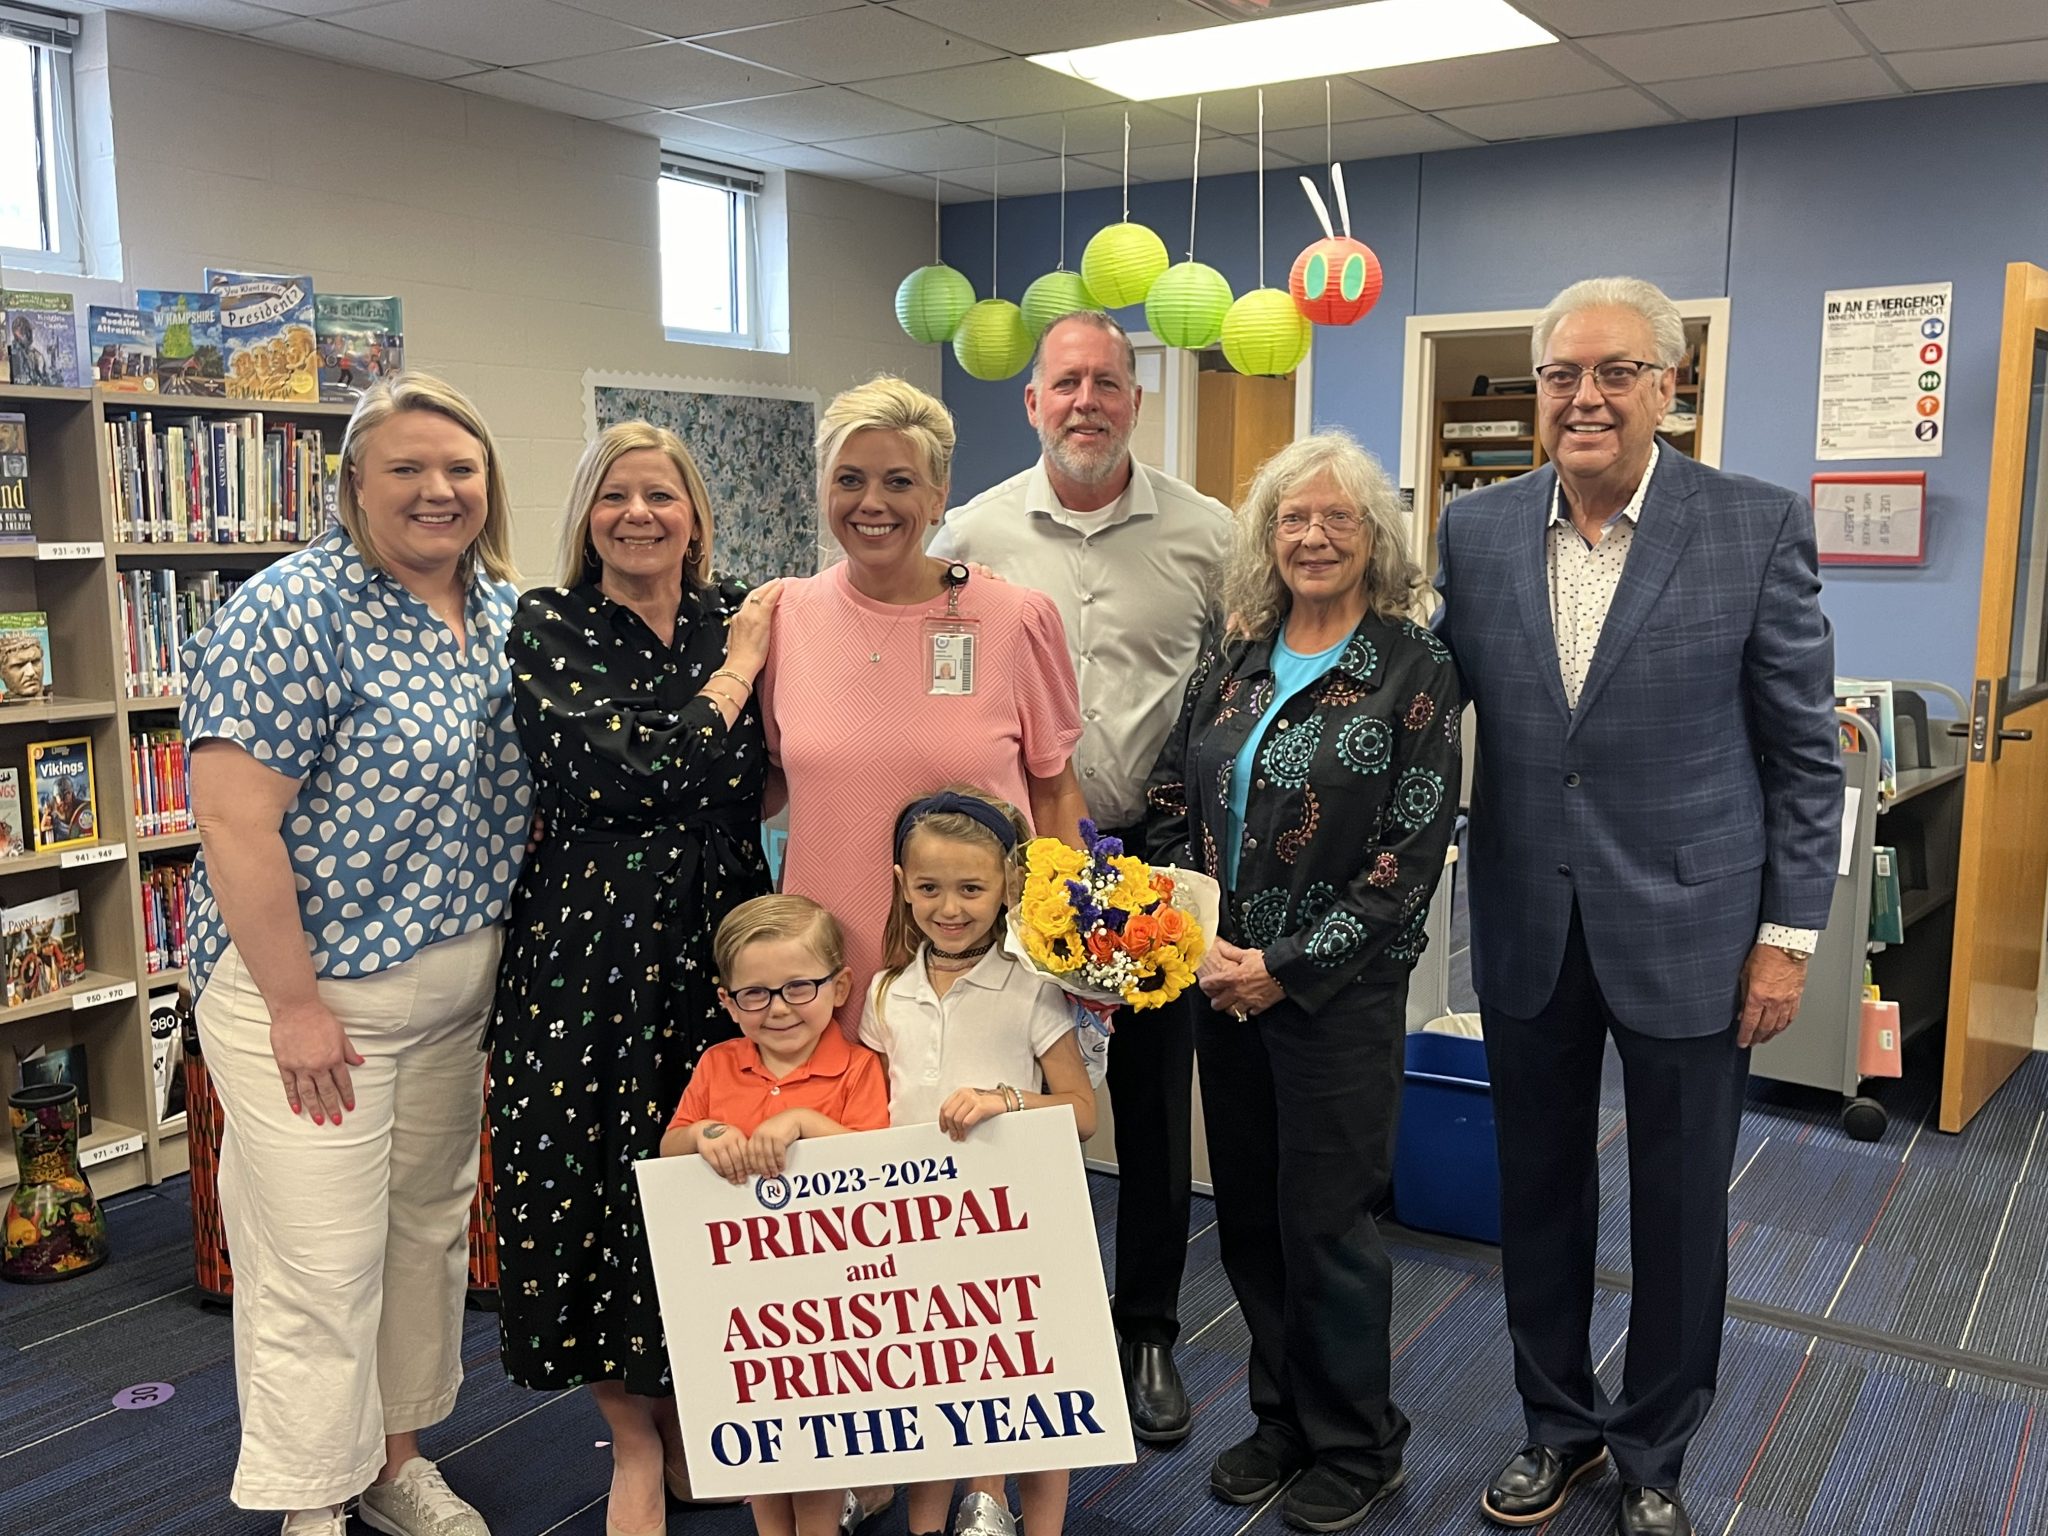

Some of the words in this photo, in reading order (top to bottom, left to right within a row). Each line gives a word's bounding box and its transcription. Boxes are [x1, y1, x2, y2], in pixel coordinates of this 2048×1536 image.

[224, 287, 239, 298] You
[240, 285, 260, 294] Want
[261, 284, 270, 292] to
[228, 288, 298, 327] President?
[1828, 302, 1841, 314] IN
[1844, 300, 1862, 312] AN
[1866, 294, 1948, 311] EMERGENCY
[100, 316, 140, 328] Roadside
[166, 310, 216, 326] HAMPSHIRE
[1828, 313, 1855, 321] WHEN
[1858, 311, 1878, 320] YOU
[1880, 309, 1905, 319] HEAR
[1920, 307, 1934, 315] DO
[97, 324, 146, 337] Attractions
[1, 479, 26, 510] nd
[52, 547, 67, 556] 931
[76, 547, 92, 555] 939
[40, 761, 85, 778] Vikings
[75, 854, 90, 863] 941
[98, 849, 113, 859] 949
[9, 914, 41, 933] PAWNE
[86, 993, 101, 1004] 950
[108, 989, 124, 999] 970
[151, 1014, 175, 1033] 980
[93, 1150, 107, 1160] 971
[115, 1143, 129, 1153] 972
[793, 1156, 958, 1200] 2023-2024
[705, 1186, 1029, 1267] PRINCIPAL
[846, 1254, 898, 1283] and
[723, 1274, 1042, 1353] ASSISTANT
[729, 1330, 1055, 1405] PRINCIPAL
[131, 1386, 159, 1404] 30
[710, 1418, 784, 1468] OF
[800, 1405, 925, 1461] THE
[936, 1390, 1106, 1448] YEAR
